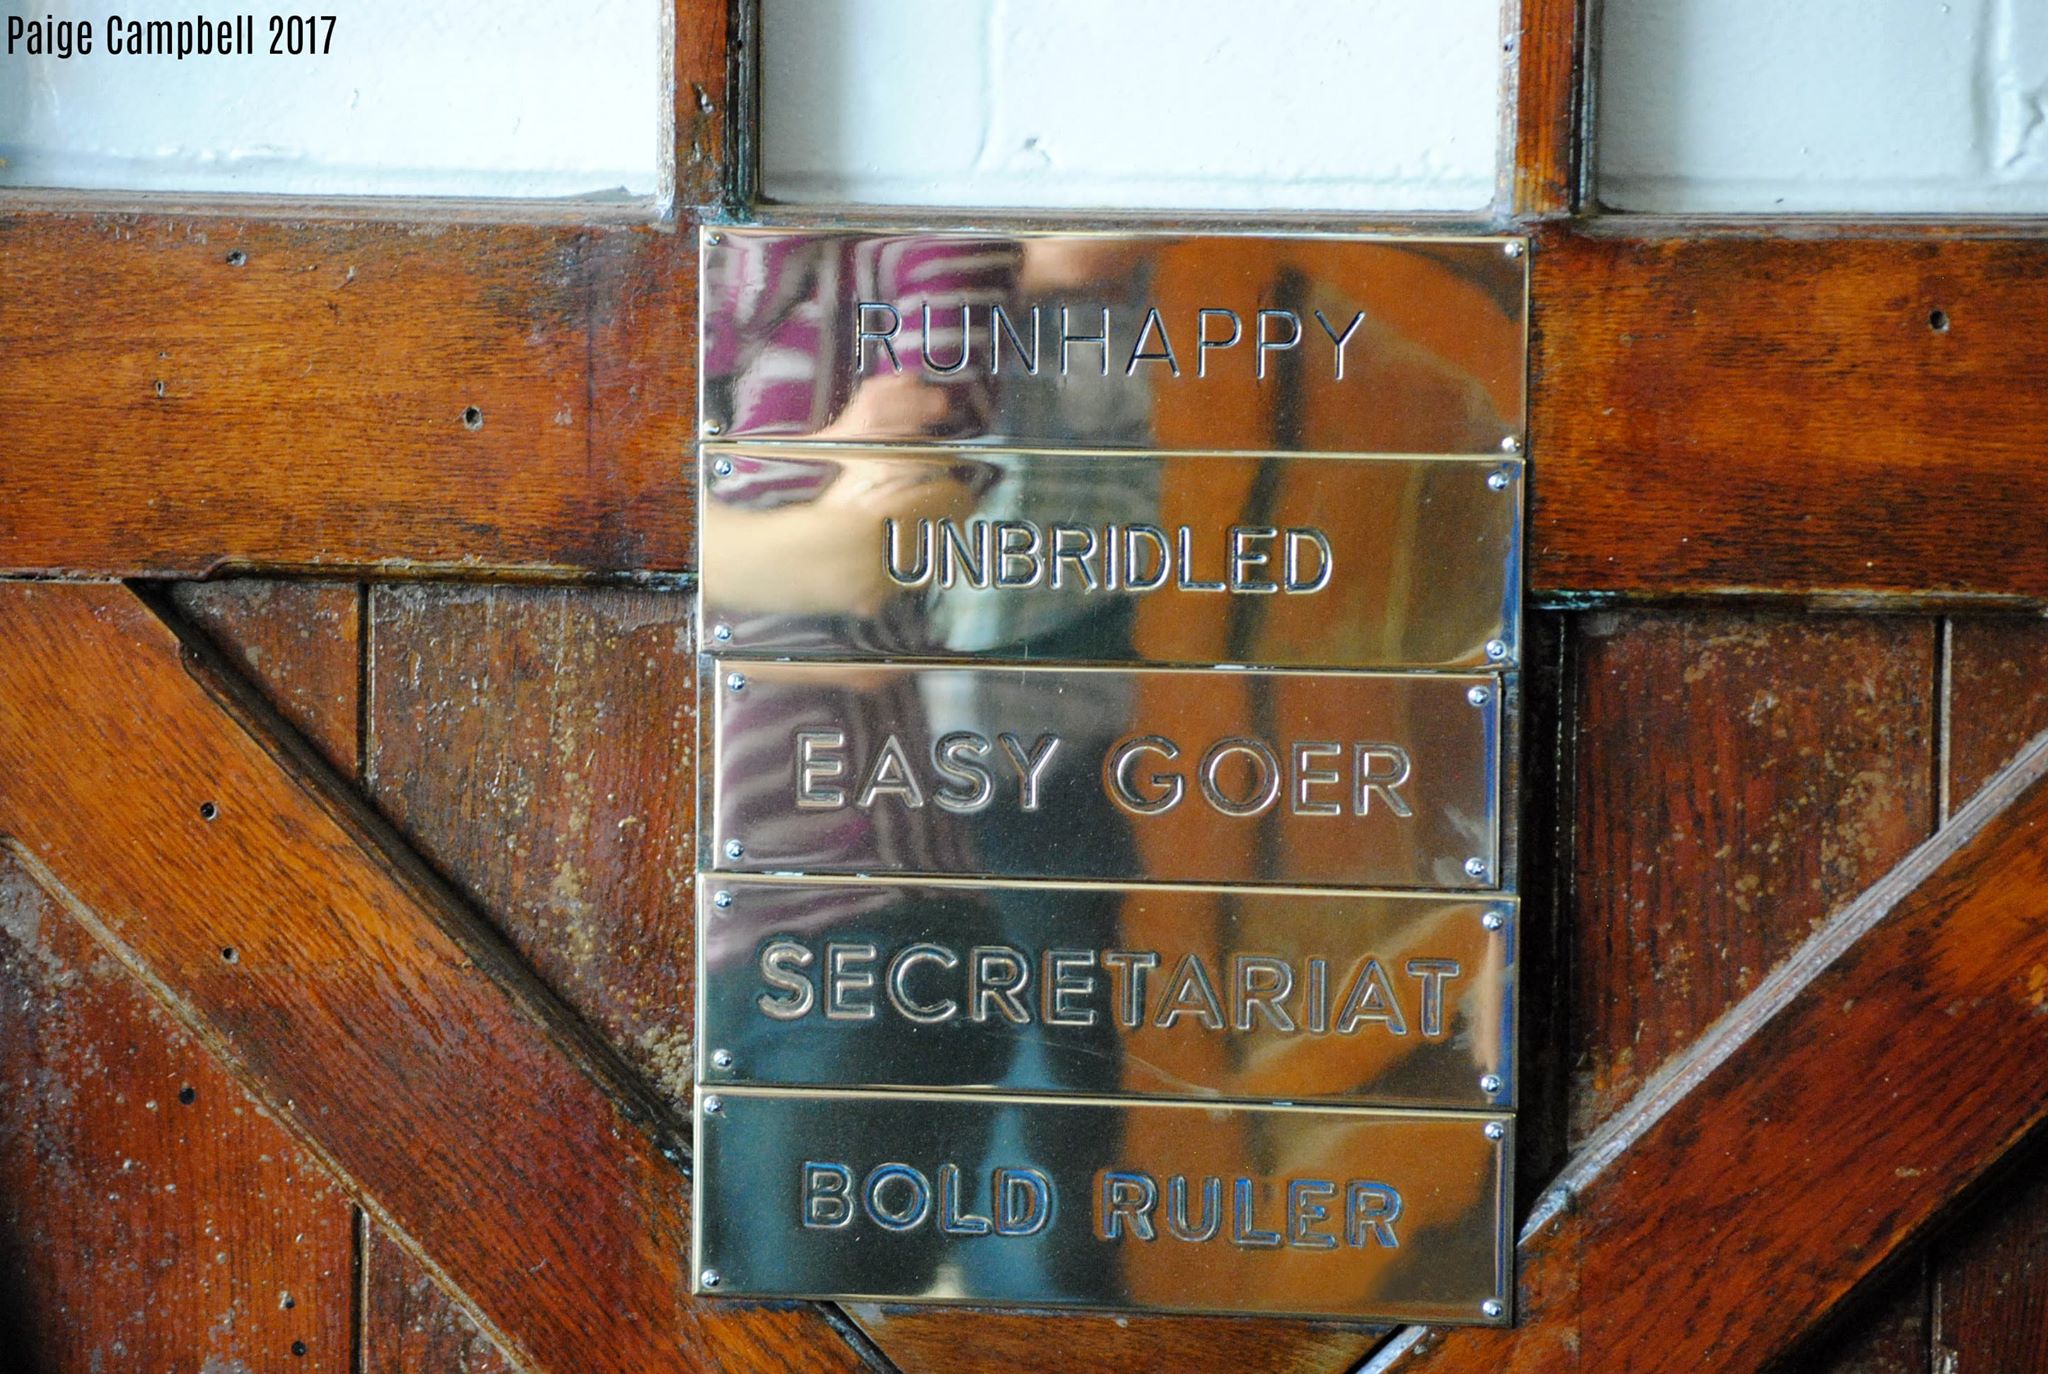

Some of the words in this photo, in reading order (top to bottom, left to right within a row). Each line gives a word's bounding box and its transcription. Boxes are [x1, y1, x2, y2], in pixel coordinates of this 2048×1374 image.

[854, 302, 1367, 381] RUNHAPPY
[883, 517, 1334, 595] UNBRIDLED
[795, 730, 1061, 813] EASY
[1105, 735, 1413, 818] GOER
[758, 940, 1461, 1037] SECRETARIAT
[802, 1161, 1055, 1237] BOLD
[1094, 1172, 1404, 1250] RULER
